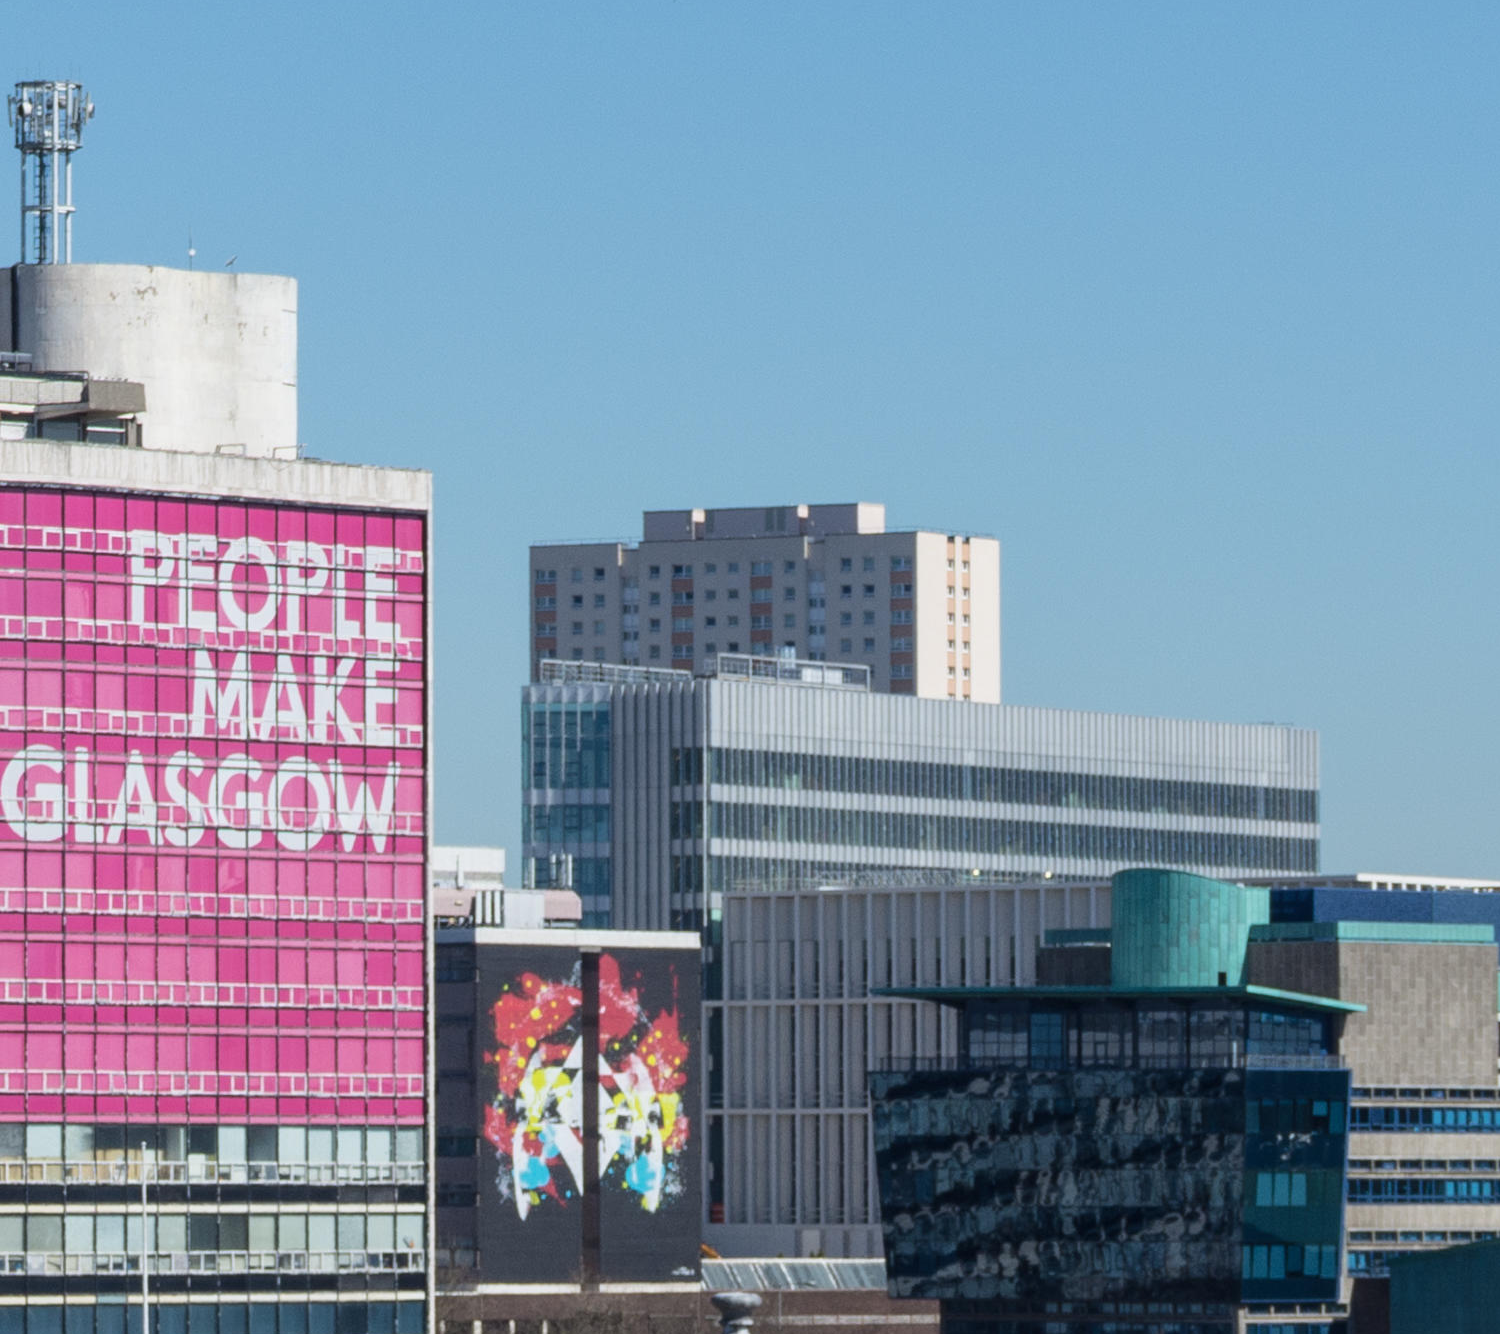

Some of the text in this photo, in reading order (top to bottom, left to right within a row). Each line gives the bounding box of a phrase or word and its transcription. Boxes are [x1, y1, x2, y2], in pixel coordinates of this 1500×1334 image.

[130, 529, 401, 641] PEOPLE
[191, 646, 401, 746] MAKE
[0, 743, 401, 854] GLASGOW
